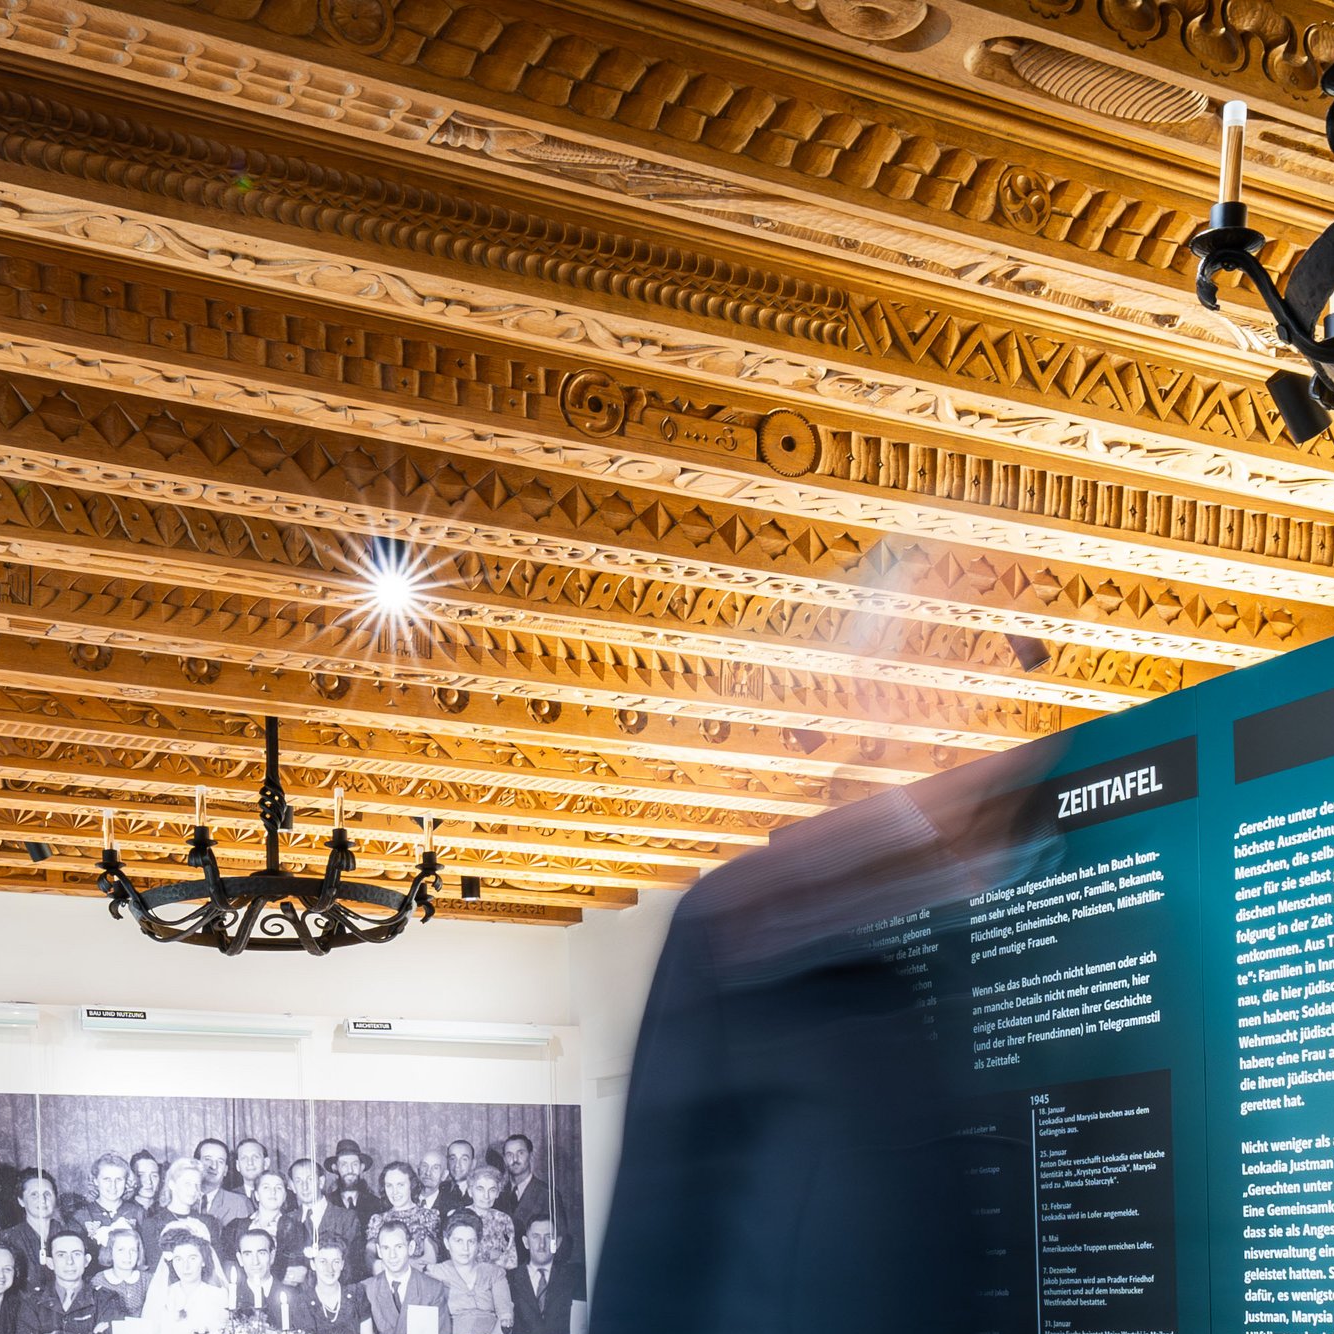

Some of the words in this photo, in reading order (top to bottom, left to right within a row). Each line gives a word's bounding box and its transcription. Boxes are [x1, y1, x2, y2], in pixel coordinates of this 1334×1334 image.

[1058, 766, 1163, 818] ZEITTAFEL
[1233, 815, 1286, 840] „Gerechte
[1287, 806, 1318, 824] unter
[1233, 839, 1276, 859] höchste
[970, 913, 987, 925] men
[988, 907, 1006, 921] sehr
[1006, 902, 1026, 916] viele
[1026, 894, 1065, 912] Personen
[1065, 890, 1083, 902] vor,
[1083, 880, 1117, 898] Familie,
[1118, 870, 1164, 890] Bekannte,
[889, 916, 905, 928] alles
[906, 913, 917, 923] um
[919, 908, 930, 920] die
[970, 926, 1014, 943] Flüchtlinge,
[1015, 911, 1071, 933] Einheimische,
[1072, 902, 1116, 920] Polizisten,
[1116, 889, 1165, 910] Mithäftlin-
[903, 927, 931, 944] geboren
[971, 952, 981, 964] ge
[982, 945, 997, 959] und
[998, 941, 1026, 955] mutige
[1027, 935, 1058, 949] Frauen.
[973, 1021, 996, 1035] einige
[997, 1015, 1033, 1030] Eckdaten
[1034, 1009, 1051, 1023] und
[1052, 1006, 1080, 1020] Fakten
[1081, 1002, 1102, 1015] ihrer
[1103, 993, 1152, 1011] Geschichte
[1030, 1094, 1050, 1106] 1945
[1048, 1107, 1066, 1115] Januar
[1063, 1114, 1076, 1123] und
[1099, 1109, 1123, 1119] brechen
[1135, 1106, 1150, 1115] dem
[1241, 1139, 1269, 1155] Nicht
[1270, 1136, 1313, 1154] weniger
[1314, 1134, 1331, 1148] als
[1101, 1153, 1129, 1163] Leokadia
[1129, 1152, 1143, 1161] eine
[1143, 1149, 1165, 1159] falsche
